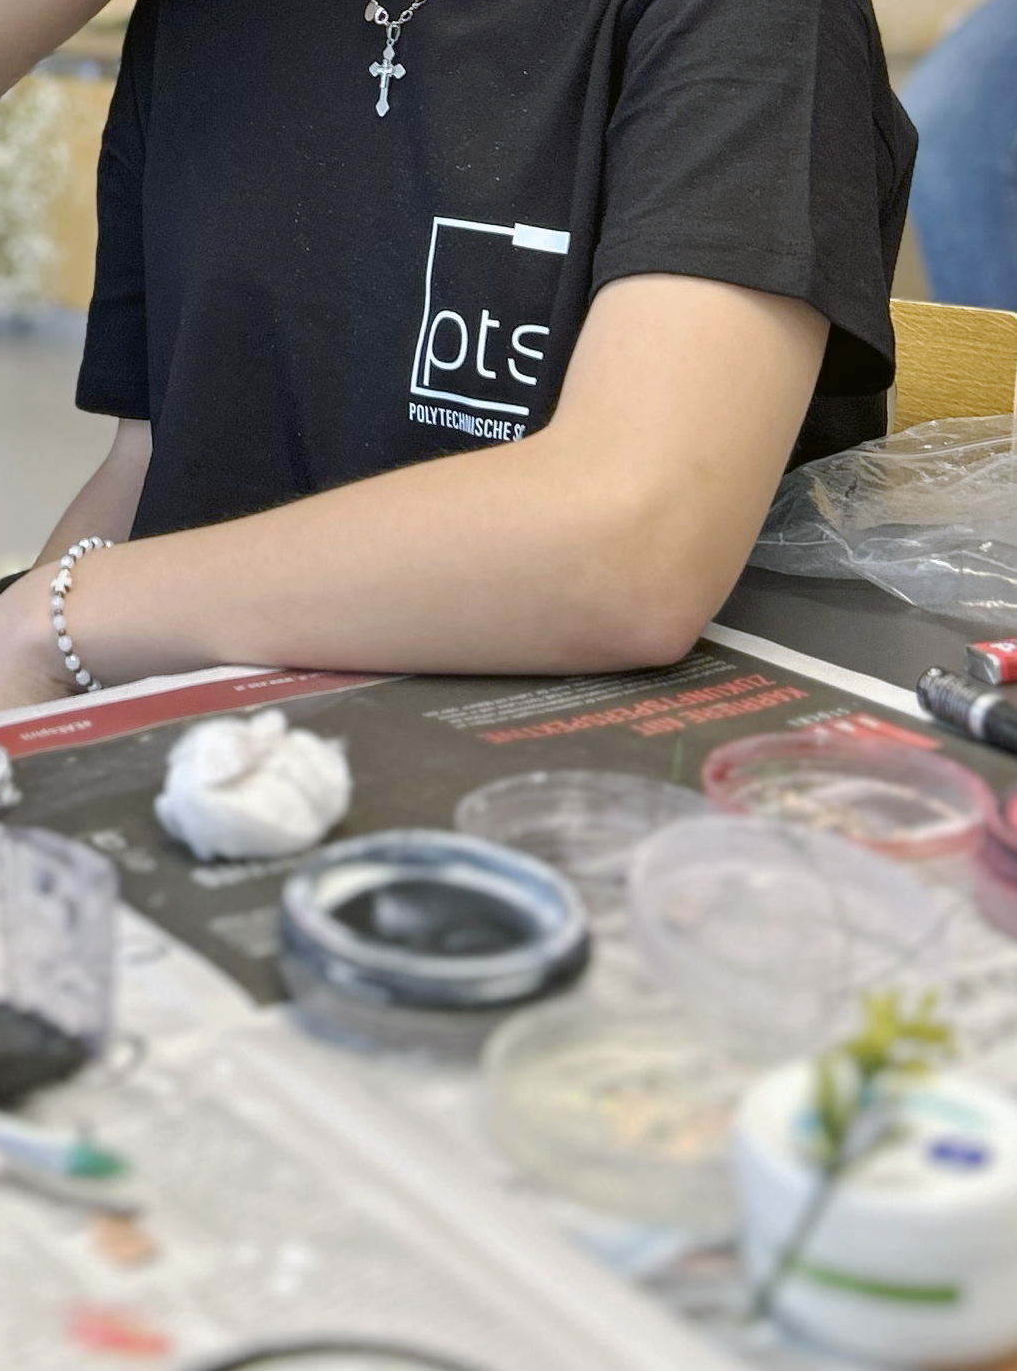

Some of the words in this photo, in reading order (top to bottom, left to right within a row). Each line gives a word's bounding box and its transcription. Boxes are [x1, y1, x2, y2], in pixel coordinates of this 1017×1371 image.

[423, 309, 550, 386] pts
[409, 401, 512, 441] POLYTECHNISCHE
[679, 685, 810, 725] KARRIERE
